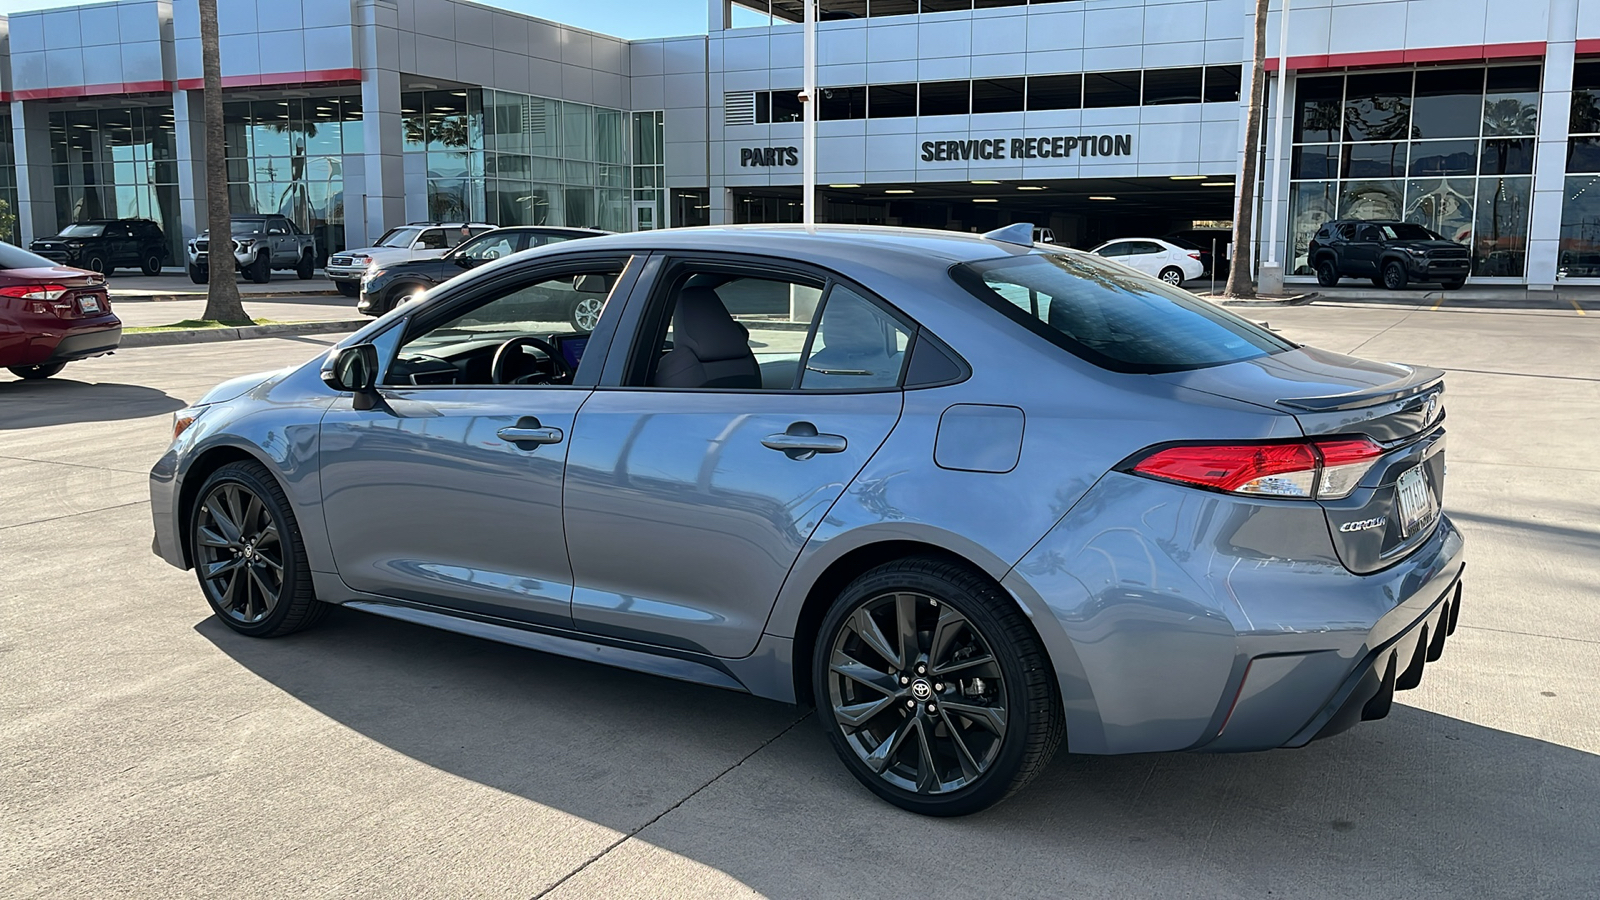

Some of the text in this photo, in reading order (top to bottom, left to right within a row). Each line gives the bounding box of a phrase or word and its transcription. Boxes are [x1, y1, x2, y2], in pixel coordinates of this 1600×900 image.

[740, 146, 799, 167] PARTS
[921, 134, 1132, 161] SERVICE RECEPTION
